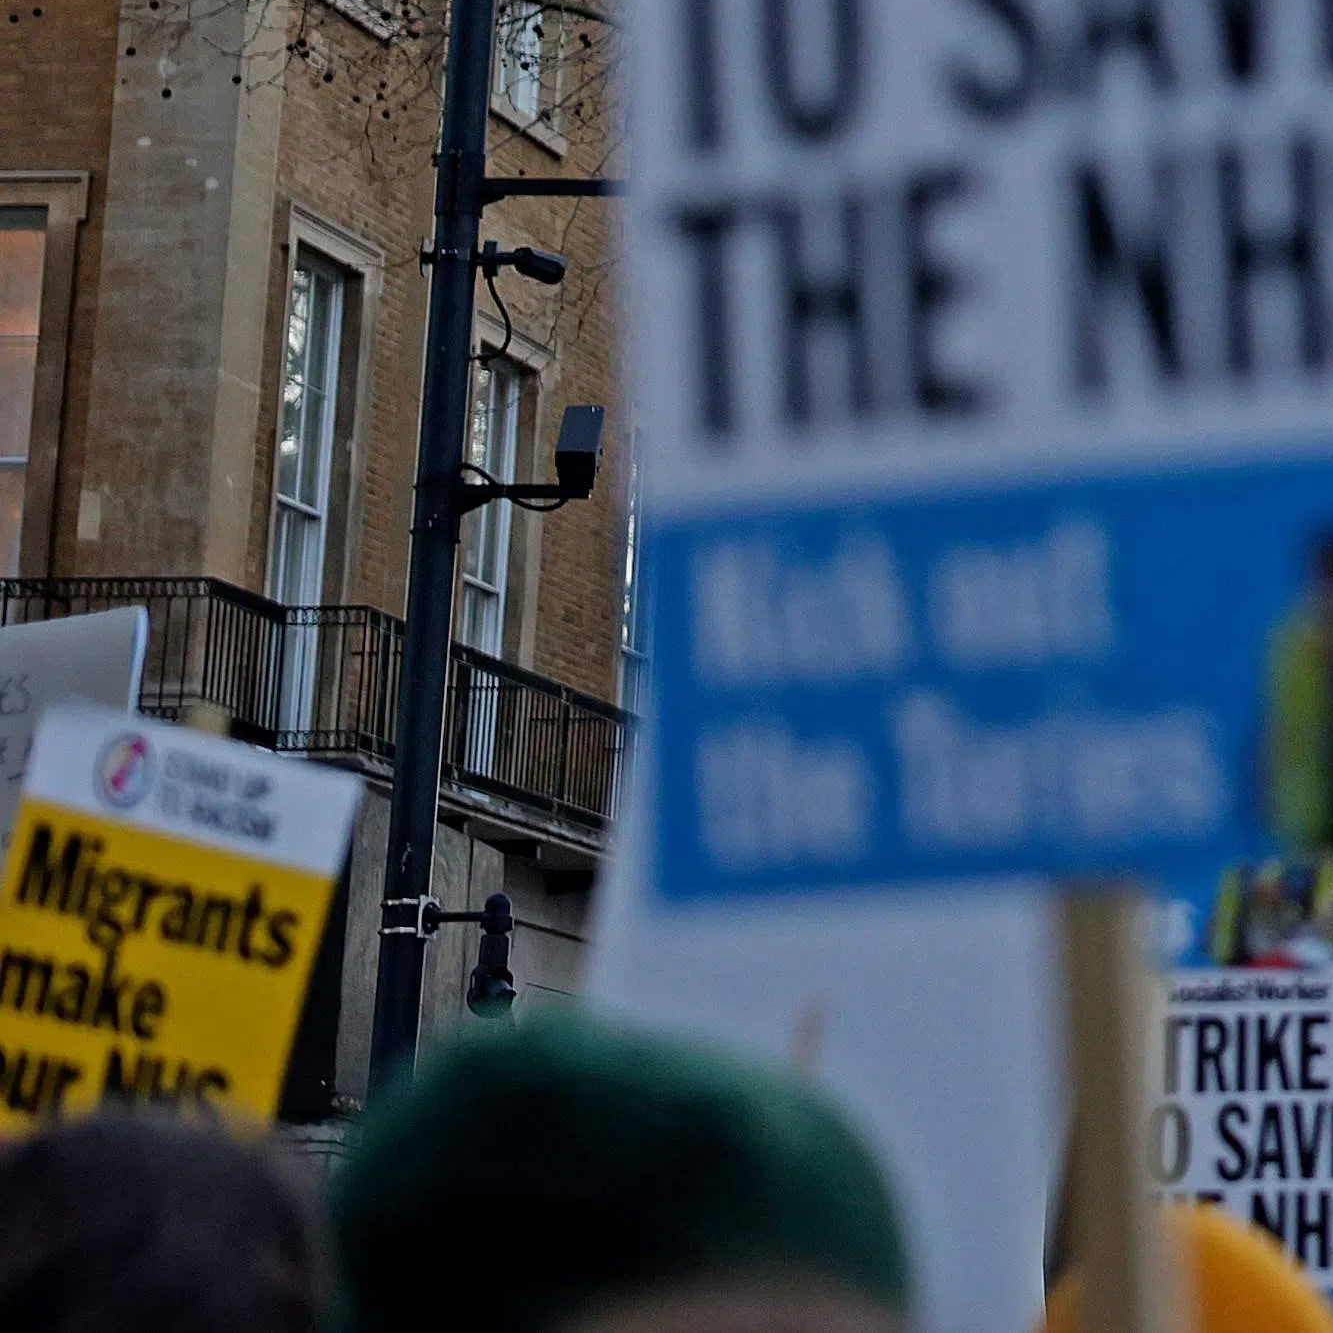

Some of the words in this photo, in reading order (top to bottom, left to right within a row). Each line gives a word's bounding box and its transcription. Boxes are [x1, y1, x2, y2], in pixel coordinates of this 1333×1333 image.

[666, 159, 995, 443] THE
[17, 821, 299, 971] Migrants
[0, 944, 166, 1040] make
[1165, 1012, 1330, 1092] TRIKE
